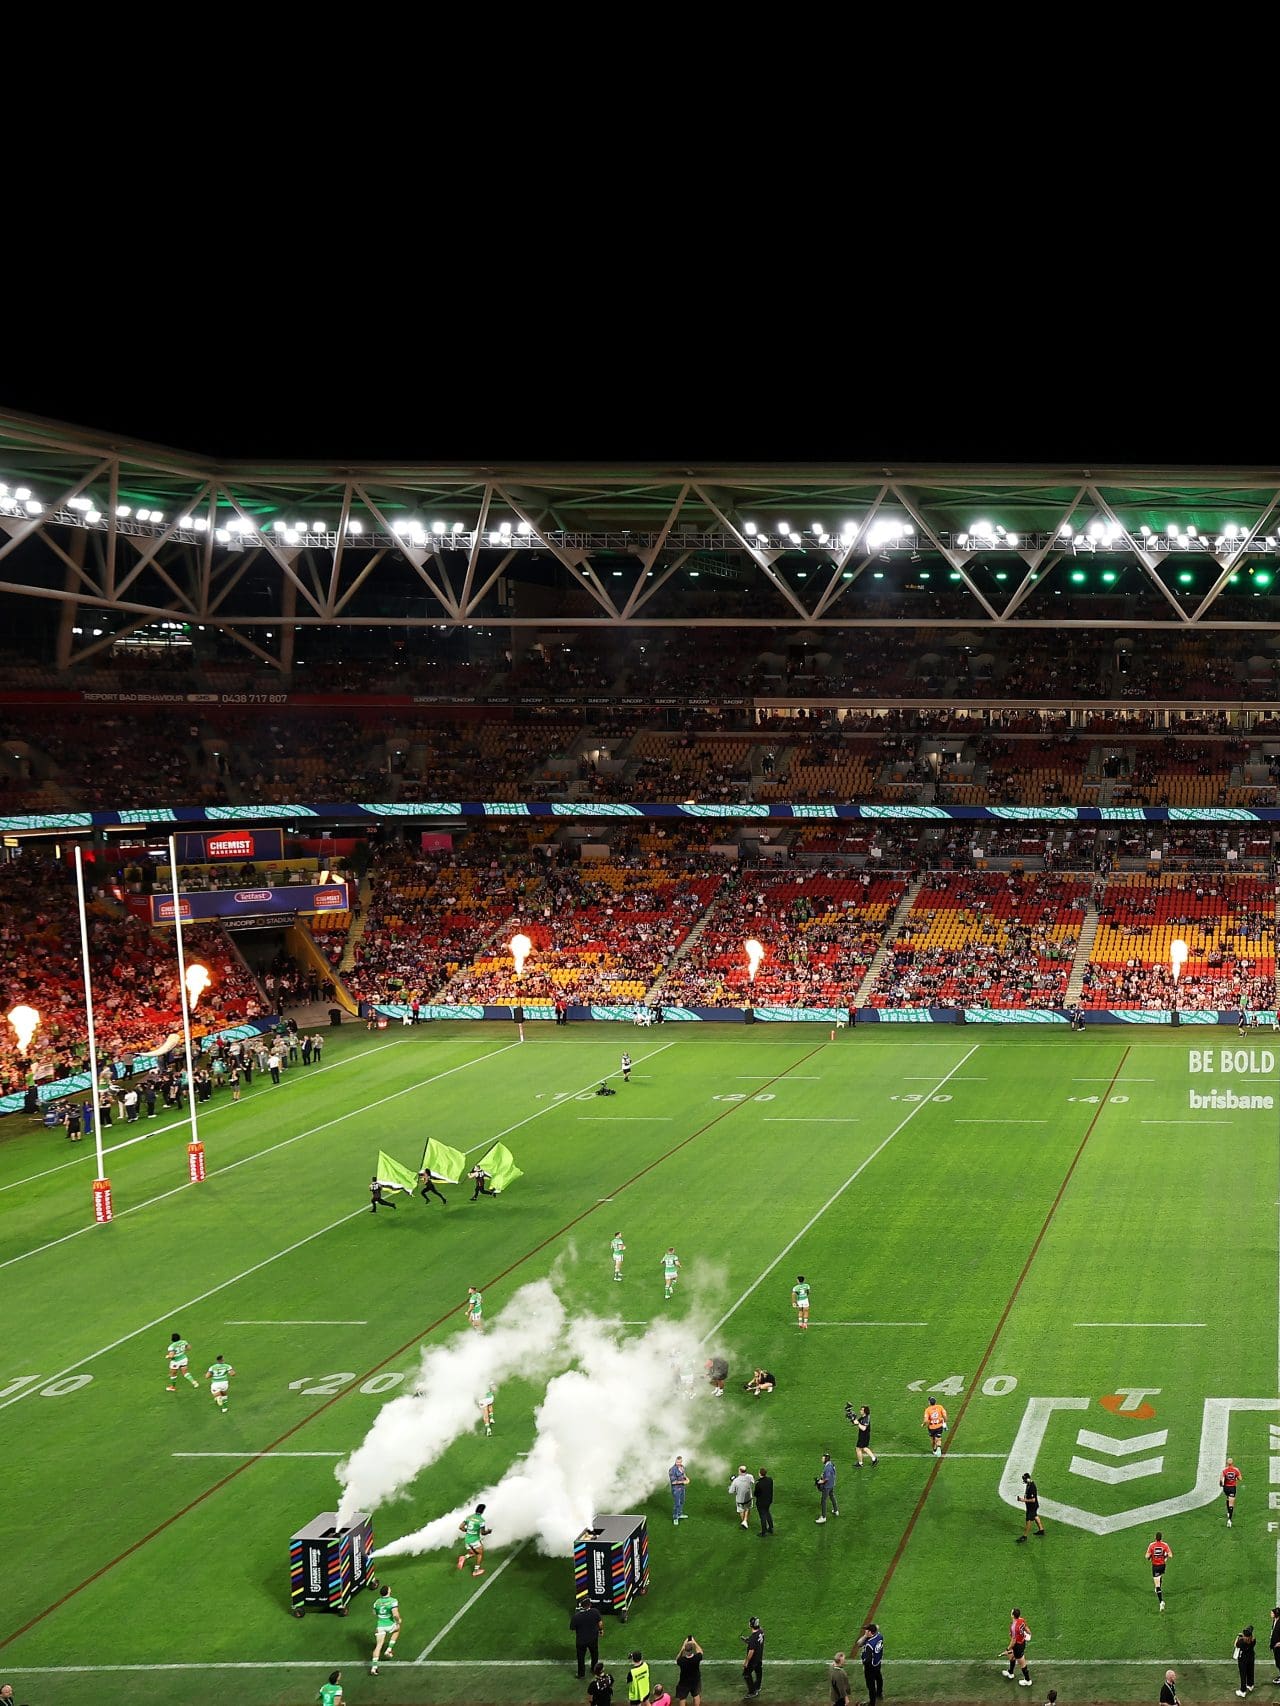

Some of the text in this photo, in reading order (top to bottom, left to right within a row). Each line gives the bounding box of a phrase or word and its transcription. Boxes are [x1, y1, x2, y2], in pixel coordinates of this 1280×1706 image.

[84, 693, 118, 701] REPORT
[137, 694, 184, 702] BEHAVIOUR
[222, 694, 247, 703] 0438
[250, 695, 268, 703] 717
[270, 695, 288, 703] 807
[210, 840, 251, 850] CHEMIST
[316, 894, 340, 902] CHEMIST
[1188, 1050, 1275, 1073] BE BOLD
[721, 1093, 776, 1101] 20
[901, 1094, 953, 1102] 30
[1079, 1095, 1130, 1103] 40
[1189, 1089, 1274, 1109] brisbane
[0, 1374, 94, 1397] 10
[300, 1372, 405, 1395] 20
[926, 1375, 1018, 1396] 40
[379, 1605, 387, 1614] 6
